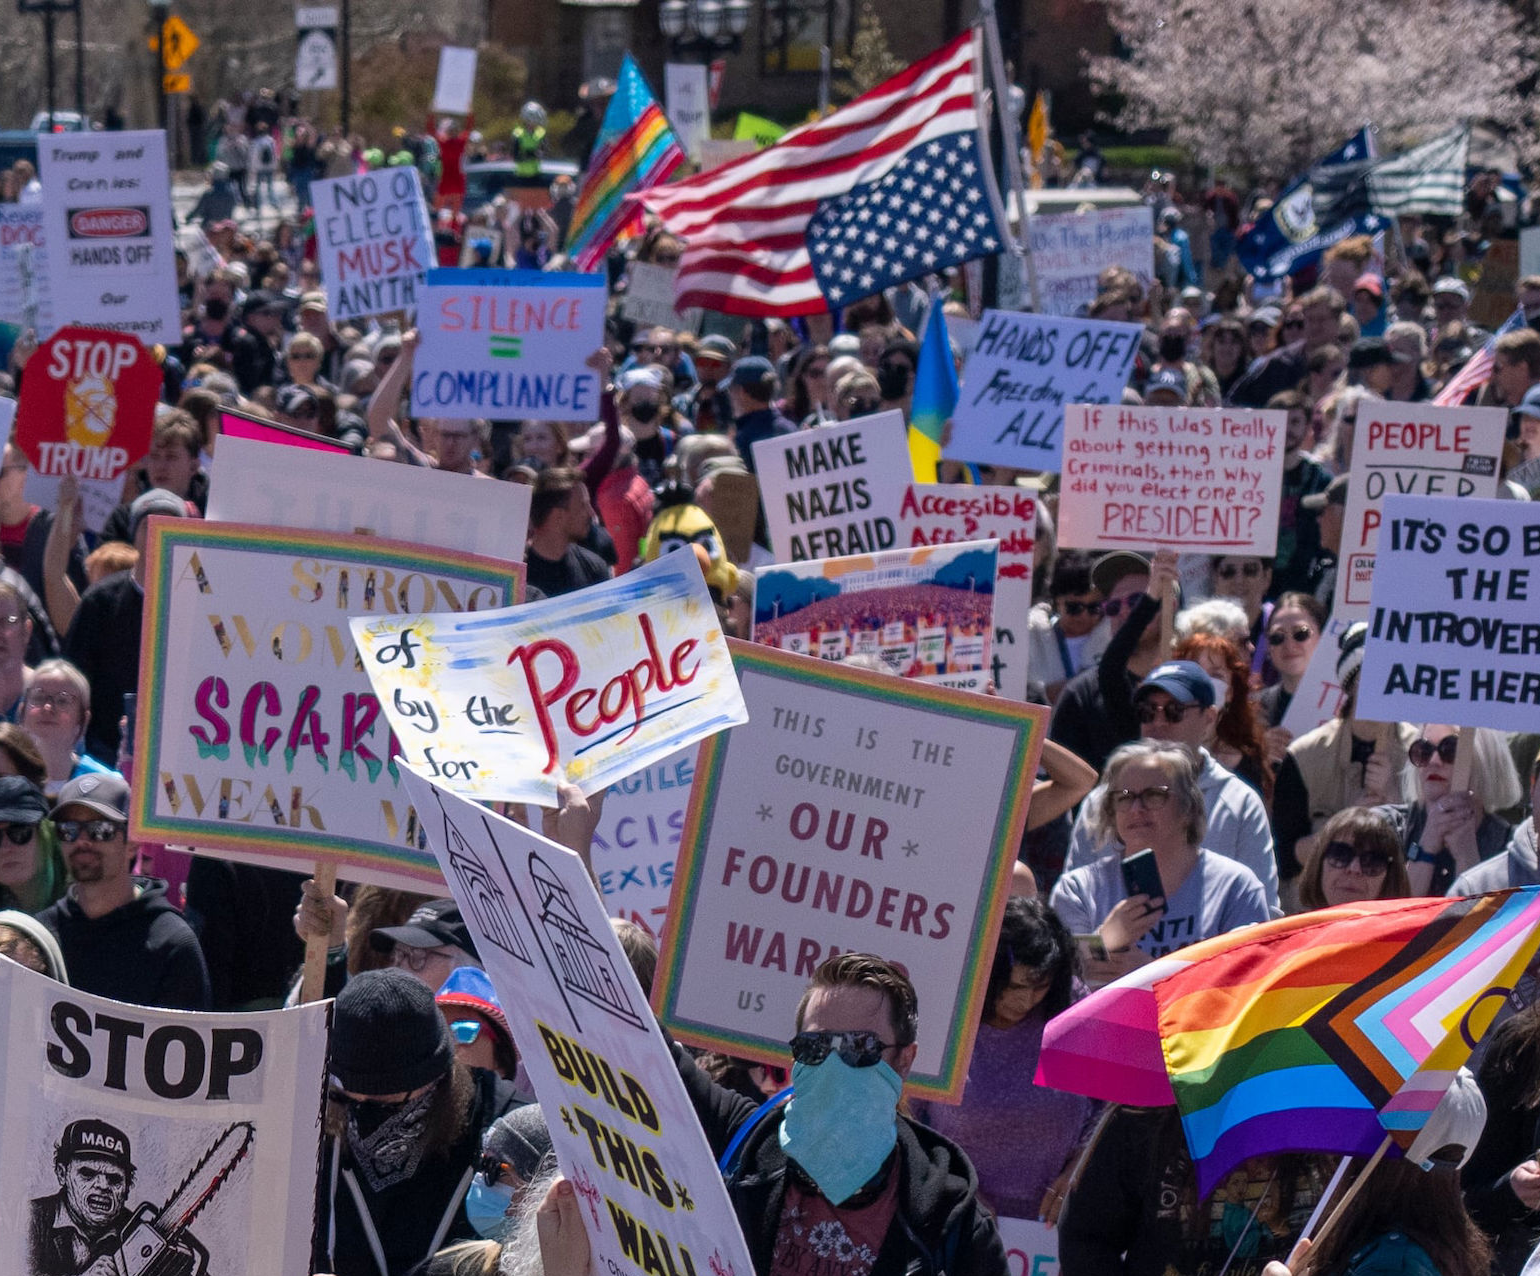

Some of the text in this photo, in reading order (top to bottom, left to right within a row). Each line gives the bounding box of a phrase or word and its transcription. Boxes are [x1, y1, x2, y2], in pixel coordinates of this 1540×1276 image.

[333, 177, 379, 211] NO
[78, 215, 142, 231] DANGER
[71, 245, 153, 265] HANDS OFF
[337, 236, 423, 282] MUSK
[100, 293, 129, 305] Our
[440, 295, 582, 334] SILENCE
[47, 339, 138, 380] STOP
[975, 315, 1141, 377] HANDS OFF!
[415, 370, 593, 410] COMPLIANCE
[995, 410, 1057, 451] ALL
[1083, 410, 1102, 432] If
[1119, 410, 1158, 435] this
[1368, 421, 1472, 453] PEOPLE
[37, 441, 128, 479] TRUMP
[784, 432, 867, 479] MAKE
[1070, 439, 1276, 464] about getting rid of
[1071, 480, 1265, 504] did you elect one as
[1169, 465, 1215, 481] then
[785, 478, 872, 524] NAZIS
[900, 484, 1035, 519] Accessible
[1102, 502, 1261, 539] PRESIDENT?
[790, 516, 897, 561] AFRAID
[1391, 518, 1447, 554] IT'S
[1457, 523, 1510, 556] SO
[174, 551, 213, 595] A
[1446, 568, 1530, 601] THE
[375, 629, 422, 668] of
[394, 612, 703, 775] by the People
[1384, 663, 1460, 700] ARE
[773, 707, 956, 768] THIS IS THE
[424, 747, 479, 780] for
[775, 754, 926, 810] GOVERNMENT
[160, 770, 327, 831] WEAK
[789, 802, 890, 861] OUR
[722, 846, 956, 940] FOUNDERS
[737, 990, 766, 1013] US
[46, 1000, 264, 1101] STOP
[537, 1020, 661, 1135] BUILD
[81, 1131, 124, 1155] MAGA
